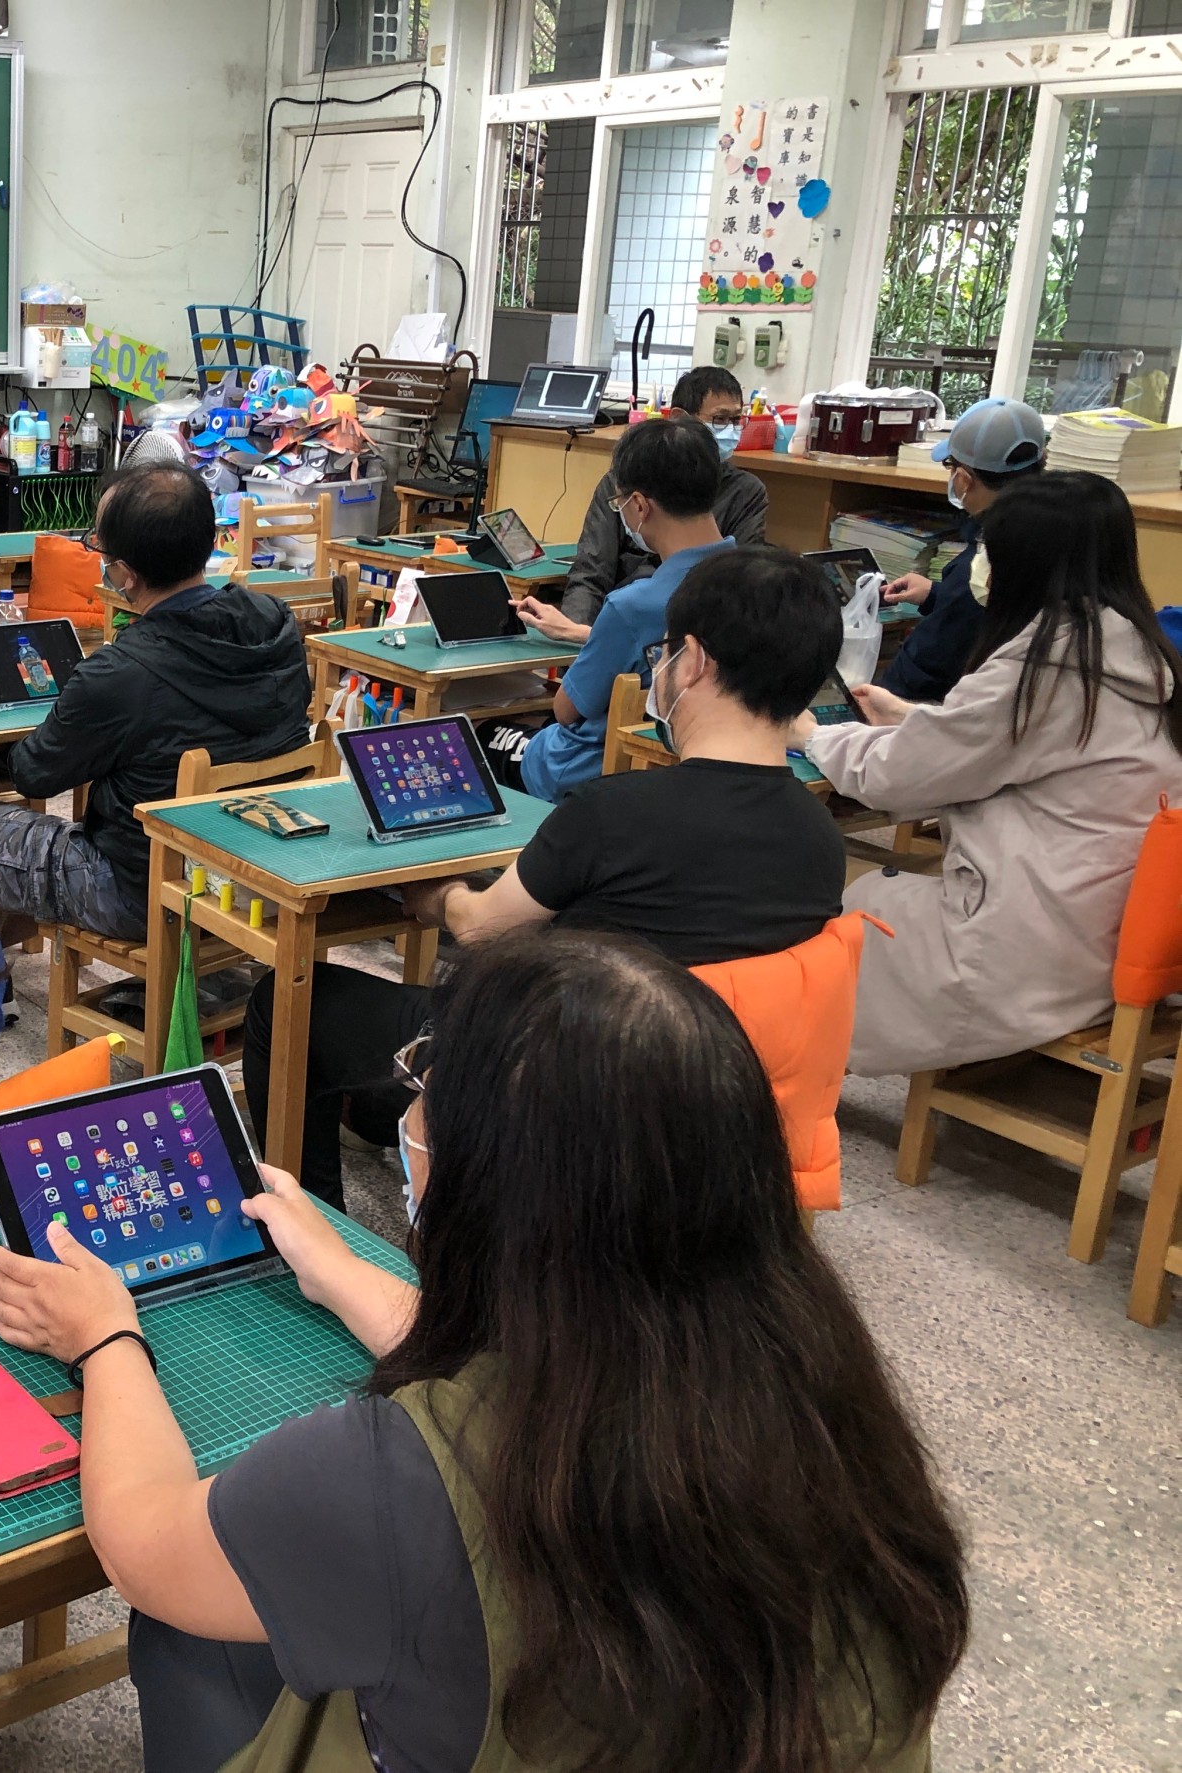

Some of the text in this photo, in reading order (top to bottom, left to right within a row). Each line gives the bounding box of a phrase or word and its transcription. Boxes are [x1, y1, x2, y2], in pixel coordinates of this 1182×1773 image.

[743, 185, 765, 263] 智慧的
[91, 336, 161, 393] 404
